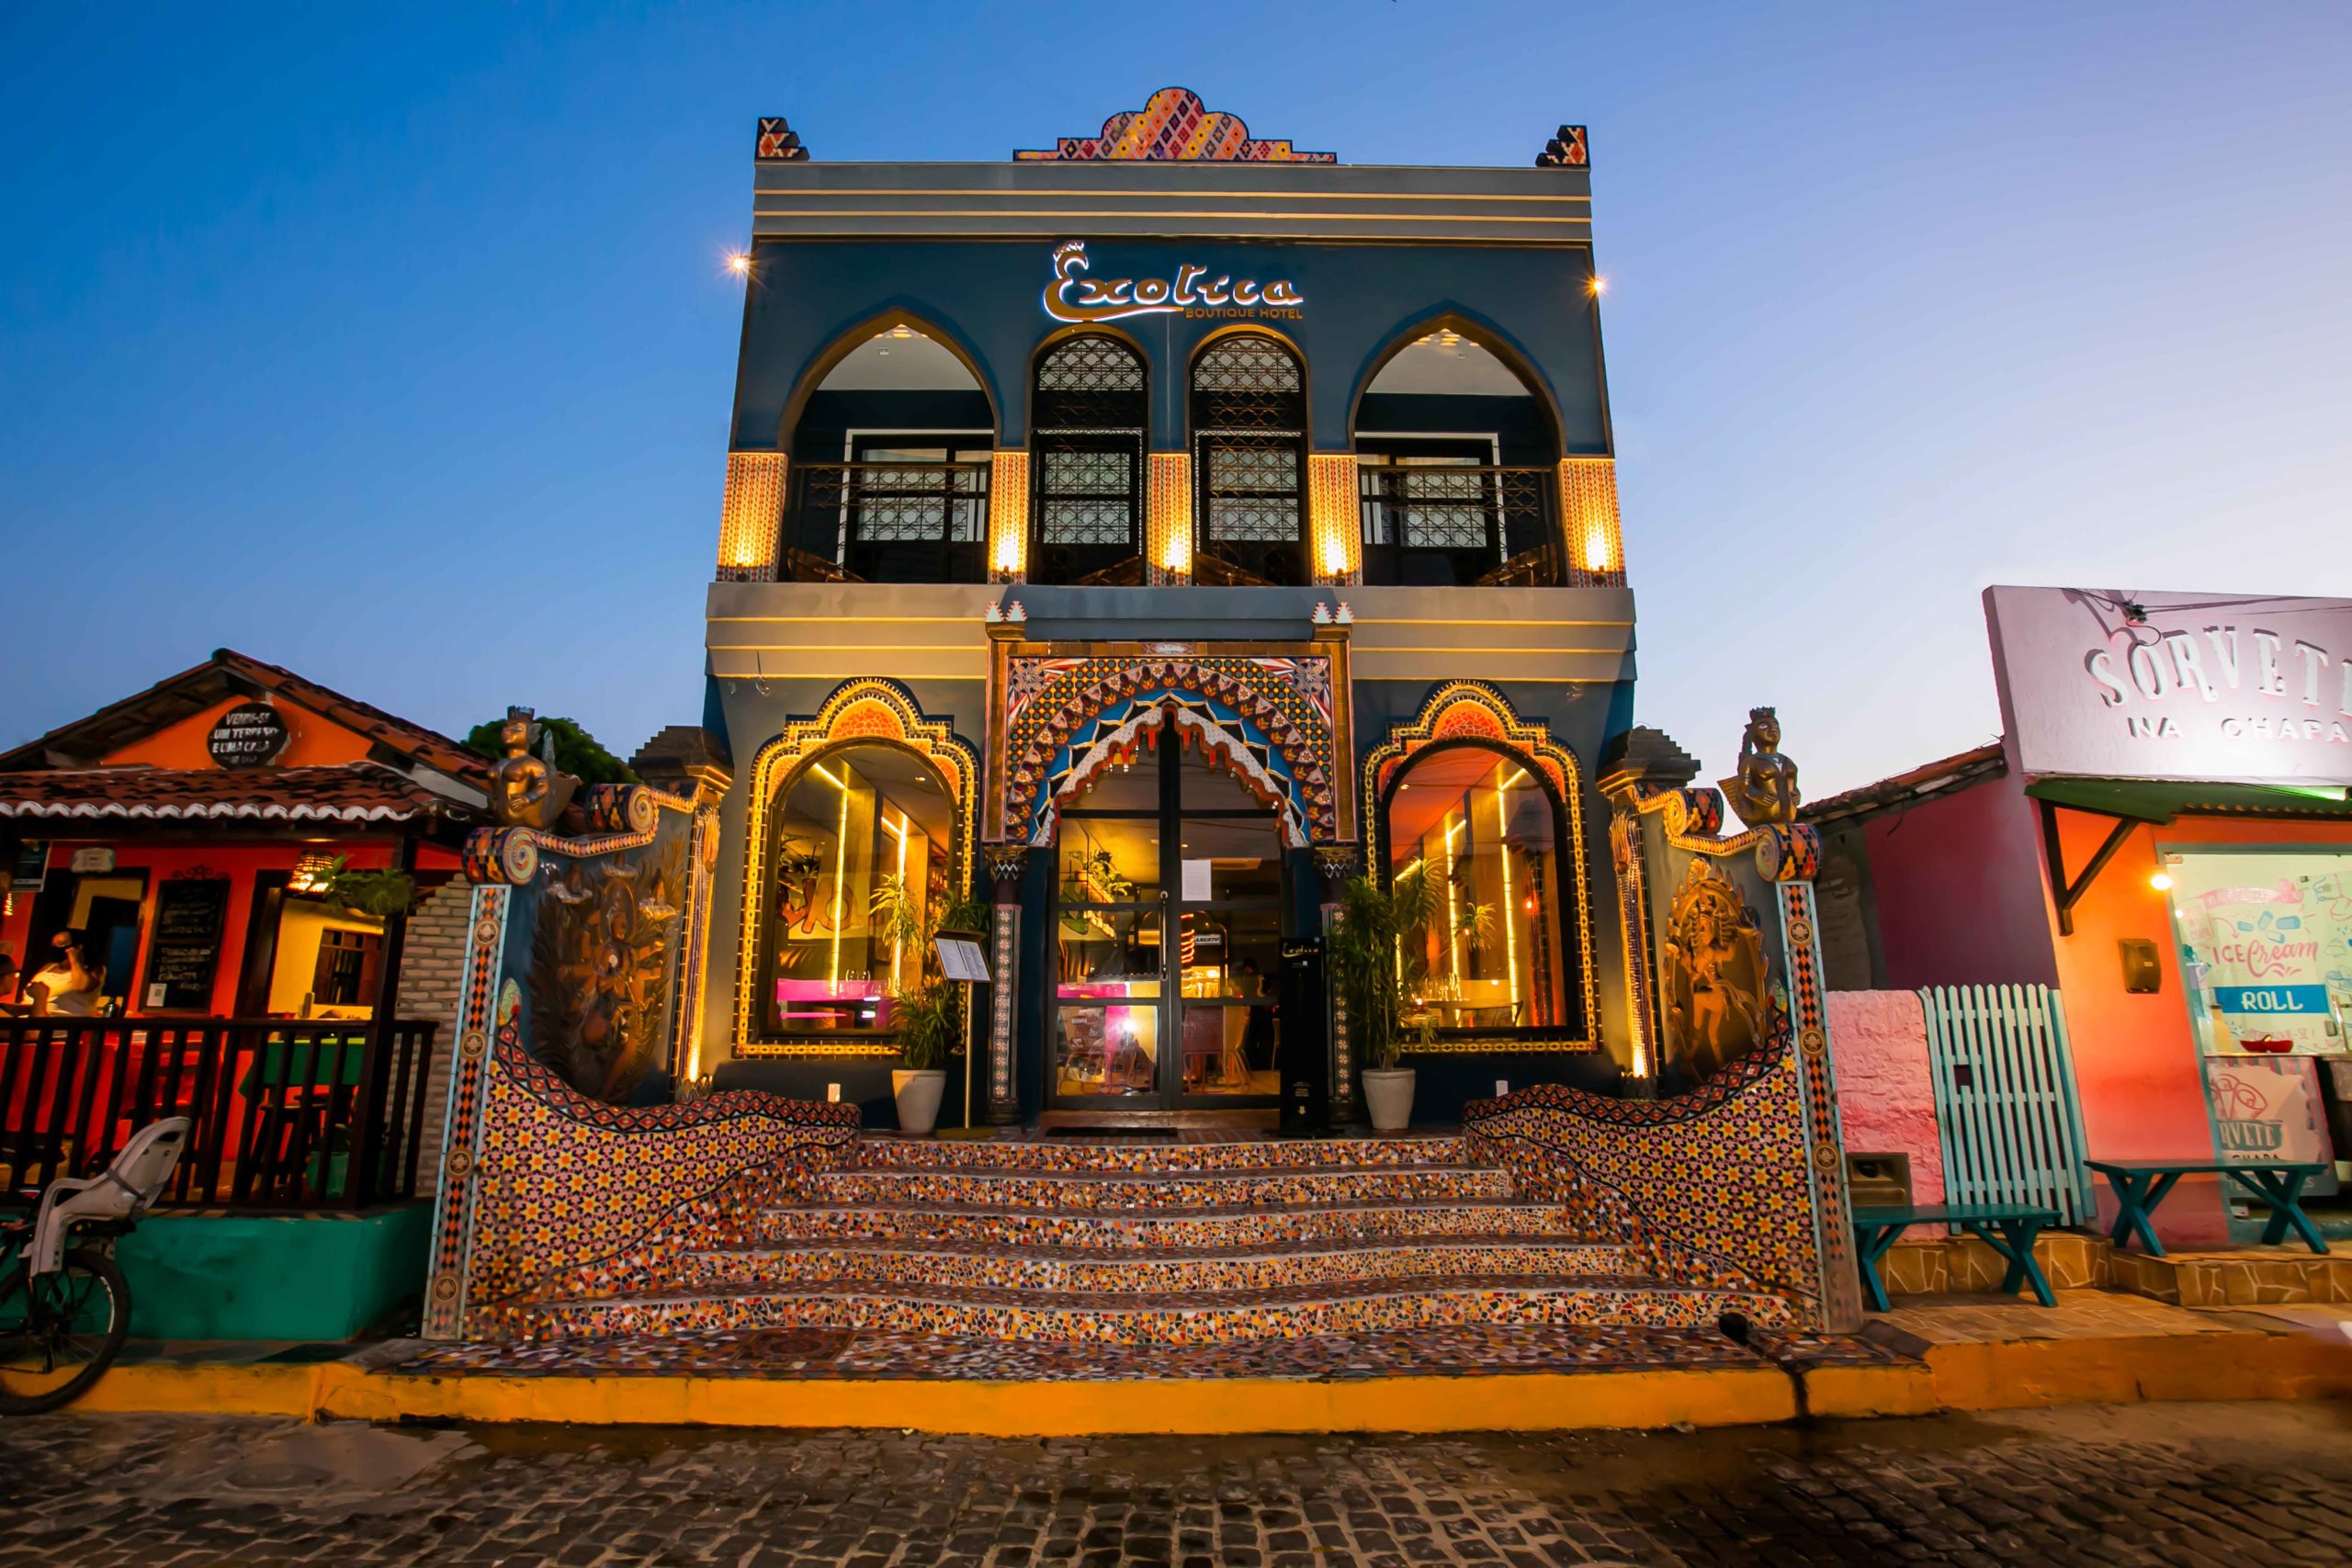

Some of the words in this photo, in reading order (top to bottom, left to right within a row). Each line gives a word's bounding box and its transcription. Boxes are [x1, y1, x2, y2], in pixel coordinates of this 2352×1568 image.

[1044, 242, 1304, 321] Exotica
[1186, 307, 1255, 319] BOUTIQUE
[1260, 308, 1304, 320] HOTEL
[2128, 716, 2183, 739] NA
[2222, 717, 2350, 743] CHAPA
[2212, 943, 2246, 964] ICE
[2246, 940, 2319, 978] Cream
[2241, 990, 2304, 1010] ROLL
[2219, 1122, 2276, 1149] RVETE
